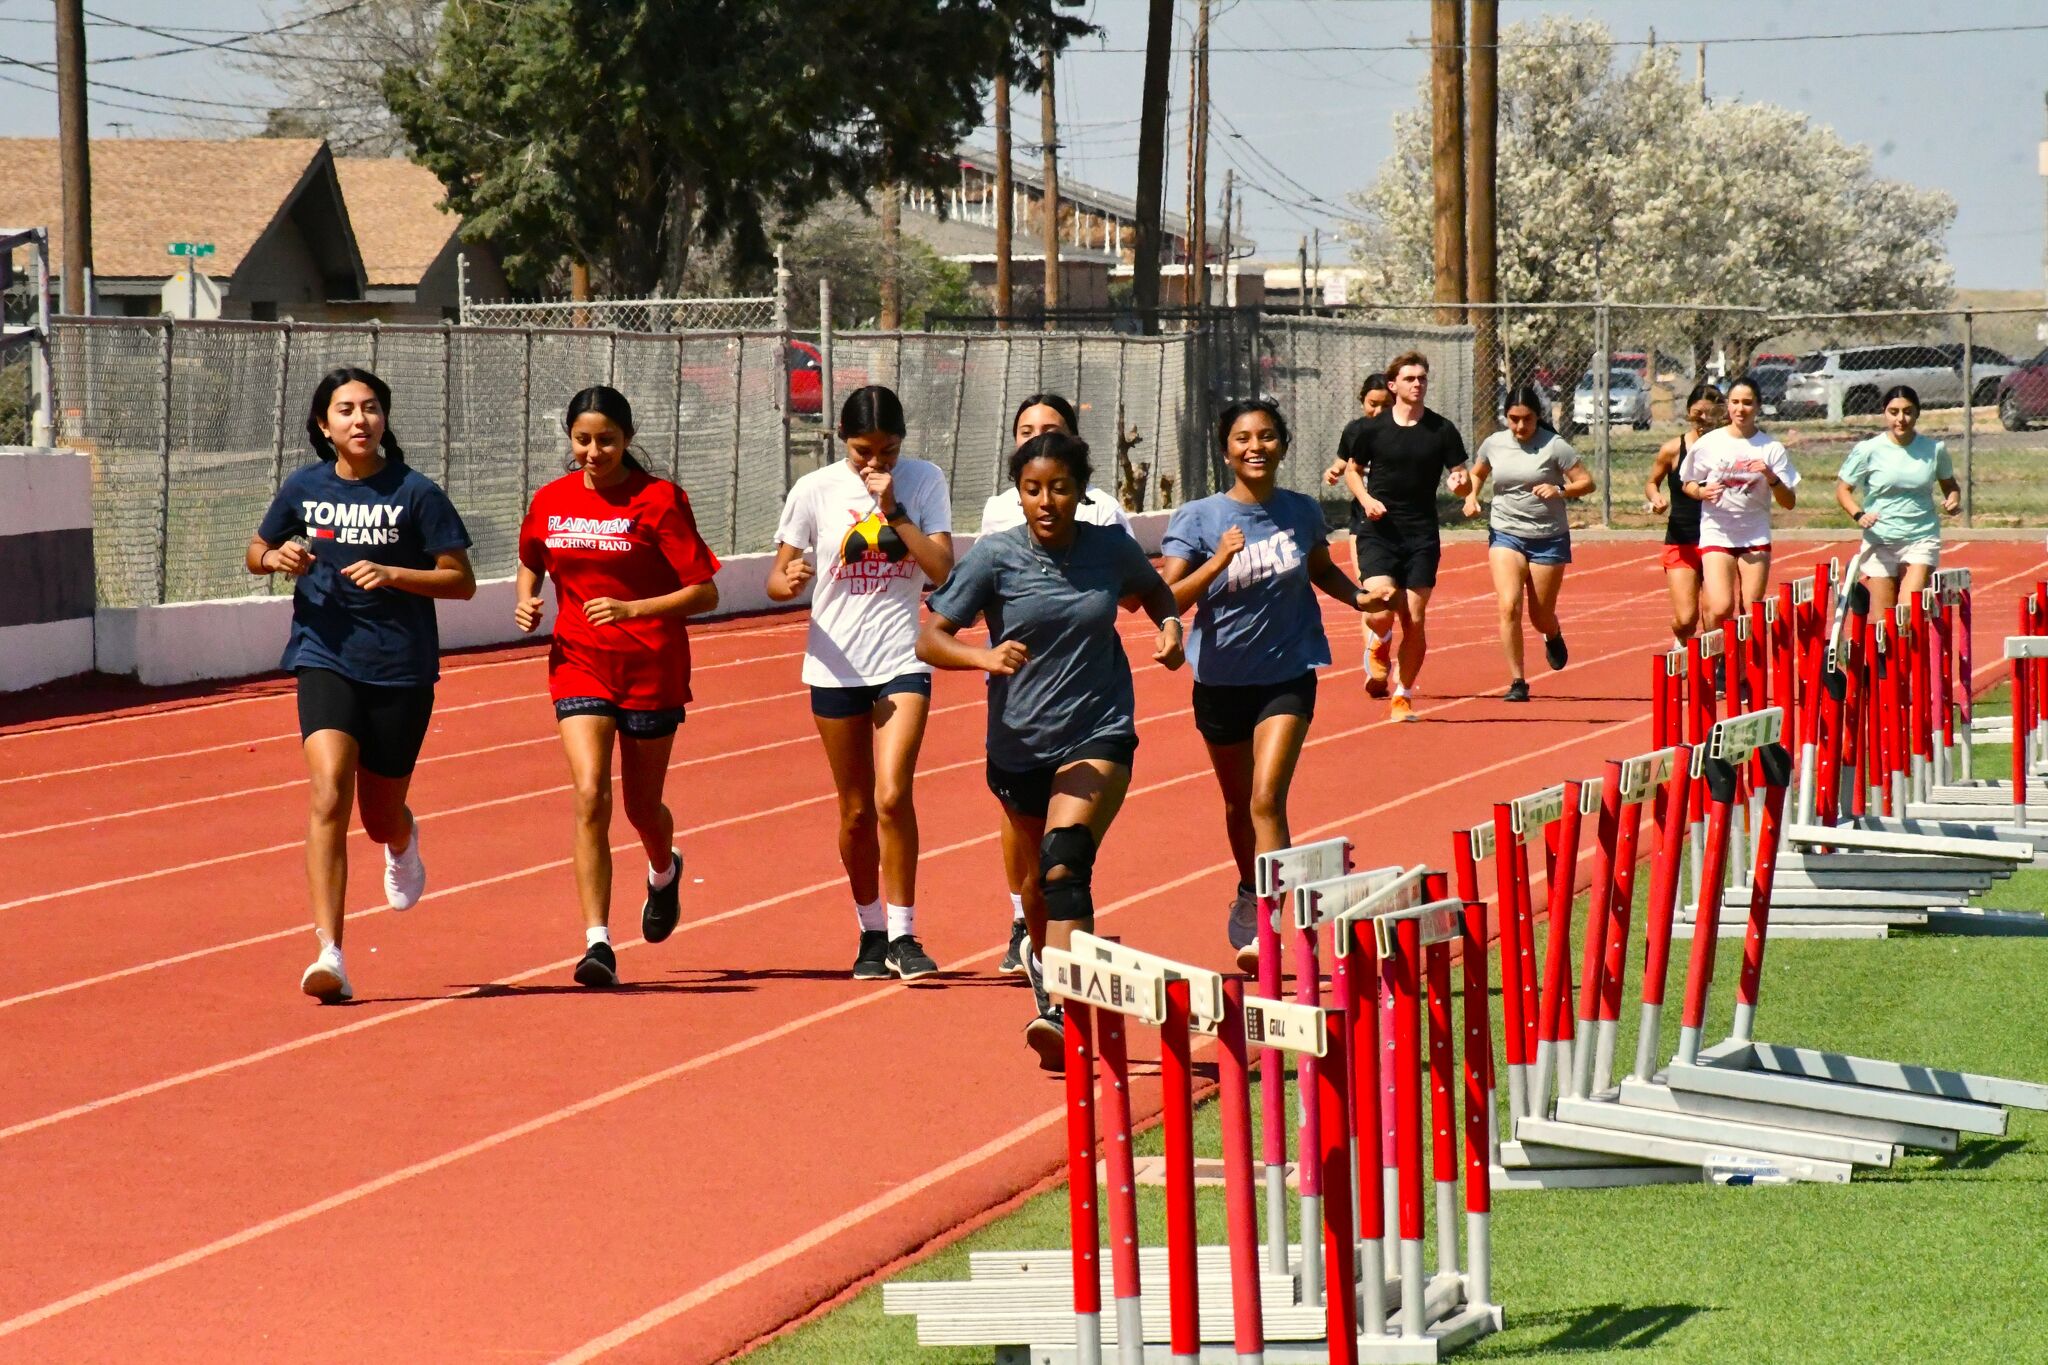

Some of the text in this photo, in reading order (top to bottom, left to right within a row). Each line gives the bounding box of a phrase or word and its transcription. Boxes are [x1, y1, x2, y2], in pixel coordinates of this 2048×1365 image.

[302, 501, 403, 527] TOMMY
[547, 515, 634, 534] PLAINVIEW
[336, 527, 400, 545] JEANS
[598, 540, 632, 552] BAND
[861, 549, 888, 561] The
[1228, 527, 1301, 592] NIKE
[1269, 1017, 1286, 1038] GILL
